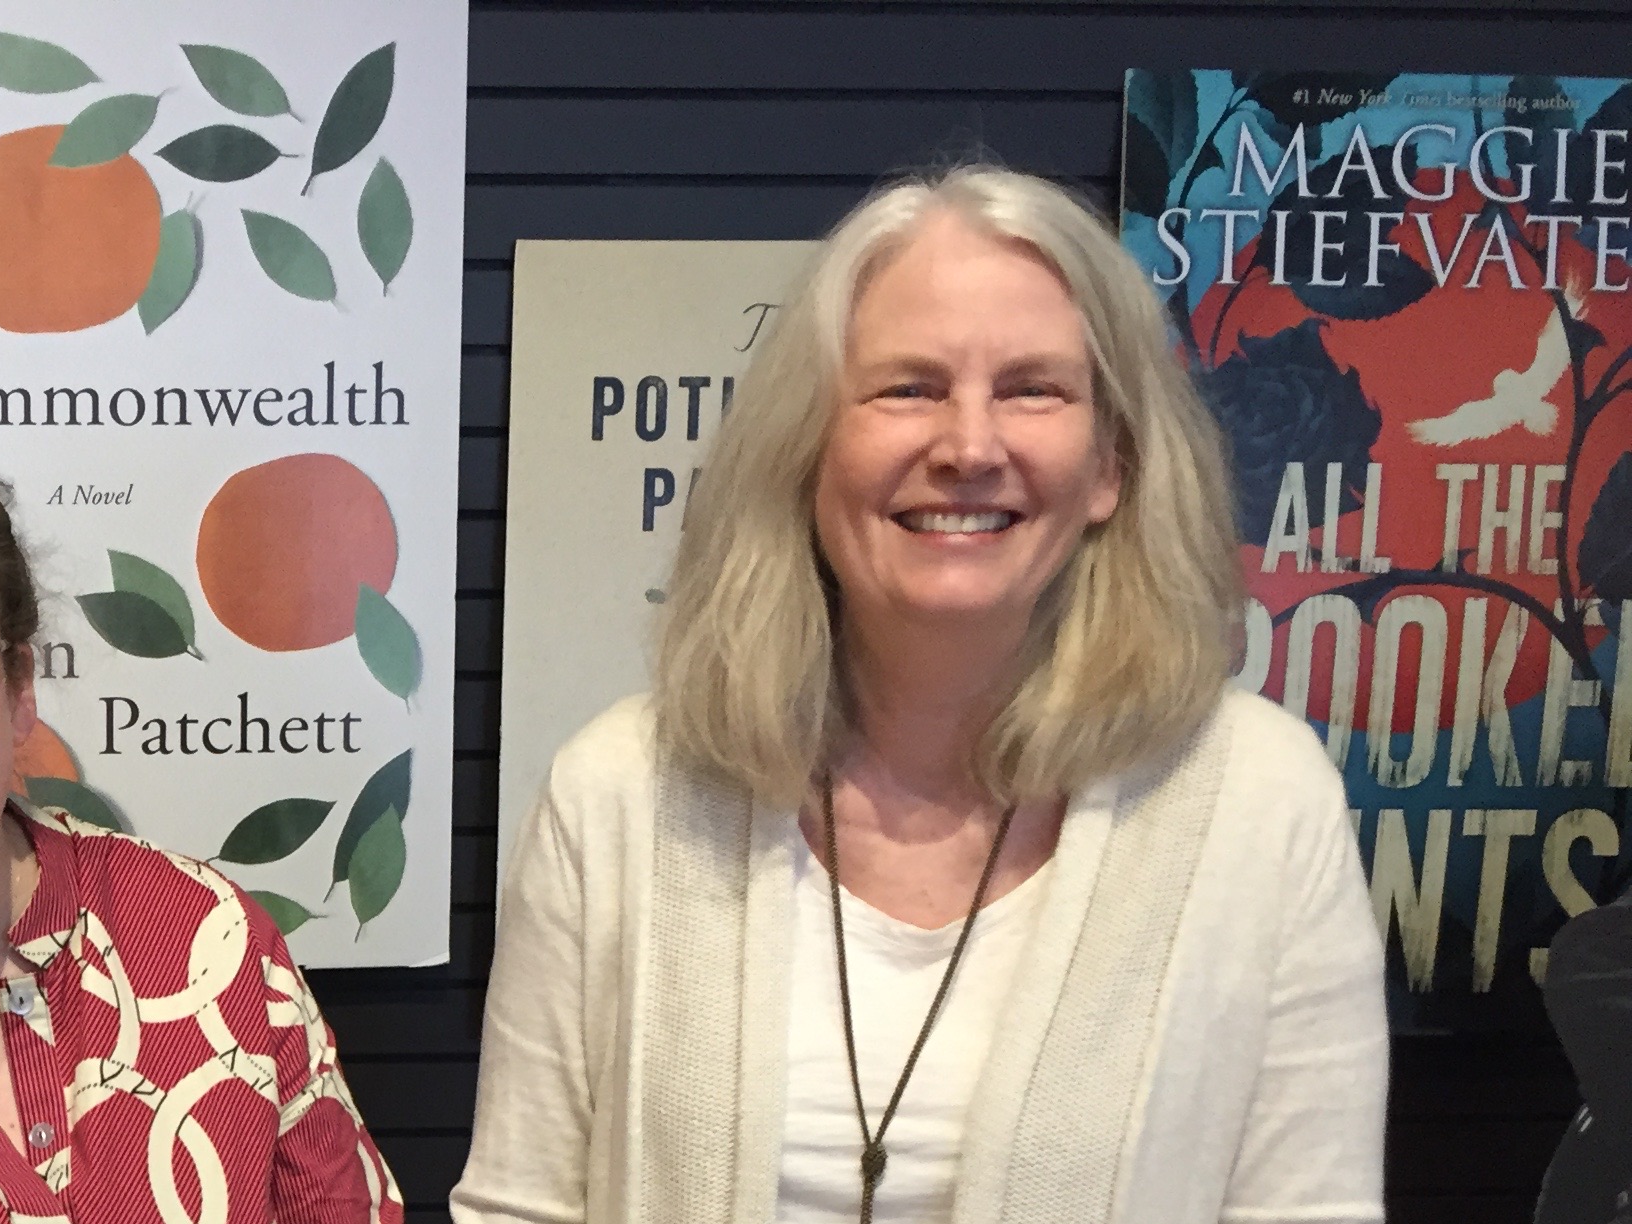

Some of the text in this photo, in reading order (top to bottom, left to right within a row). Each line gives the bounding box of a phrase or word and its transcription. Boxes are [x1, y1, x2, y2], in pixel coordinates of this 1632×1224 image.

[1292, 88, 1310, 105] #1
[1318, 88, 1353, 106] New
[1358, 88, 1393, 106] York
[1446, 92, 1527, 113] bestselling
[1532, 92, 1582, 110] author
[1228, 121, 1629, 205] MAGGIE
[1152, 207, 1631, 292] STIEFVATE
[46, 483, 134, 506] A Novel
[1260, 461, 1568, 575] ALL THE
[98, 692, 363, 756] Patchett
[1350, 807, 1620, 993] NTS
